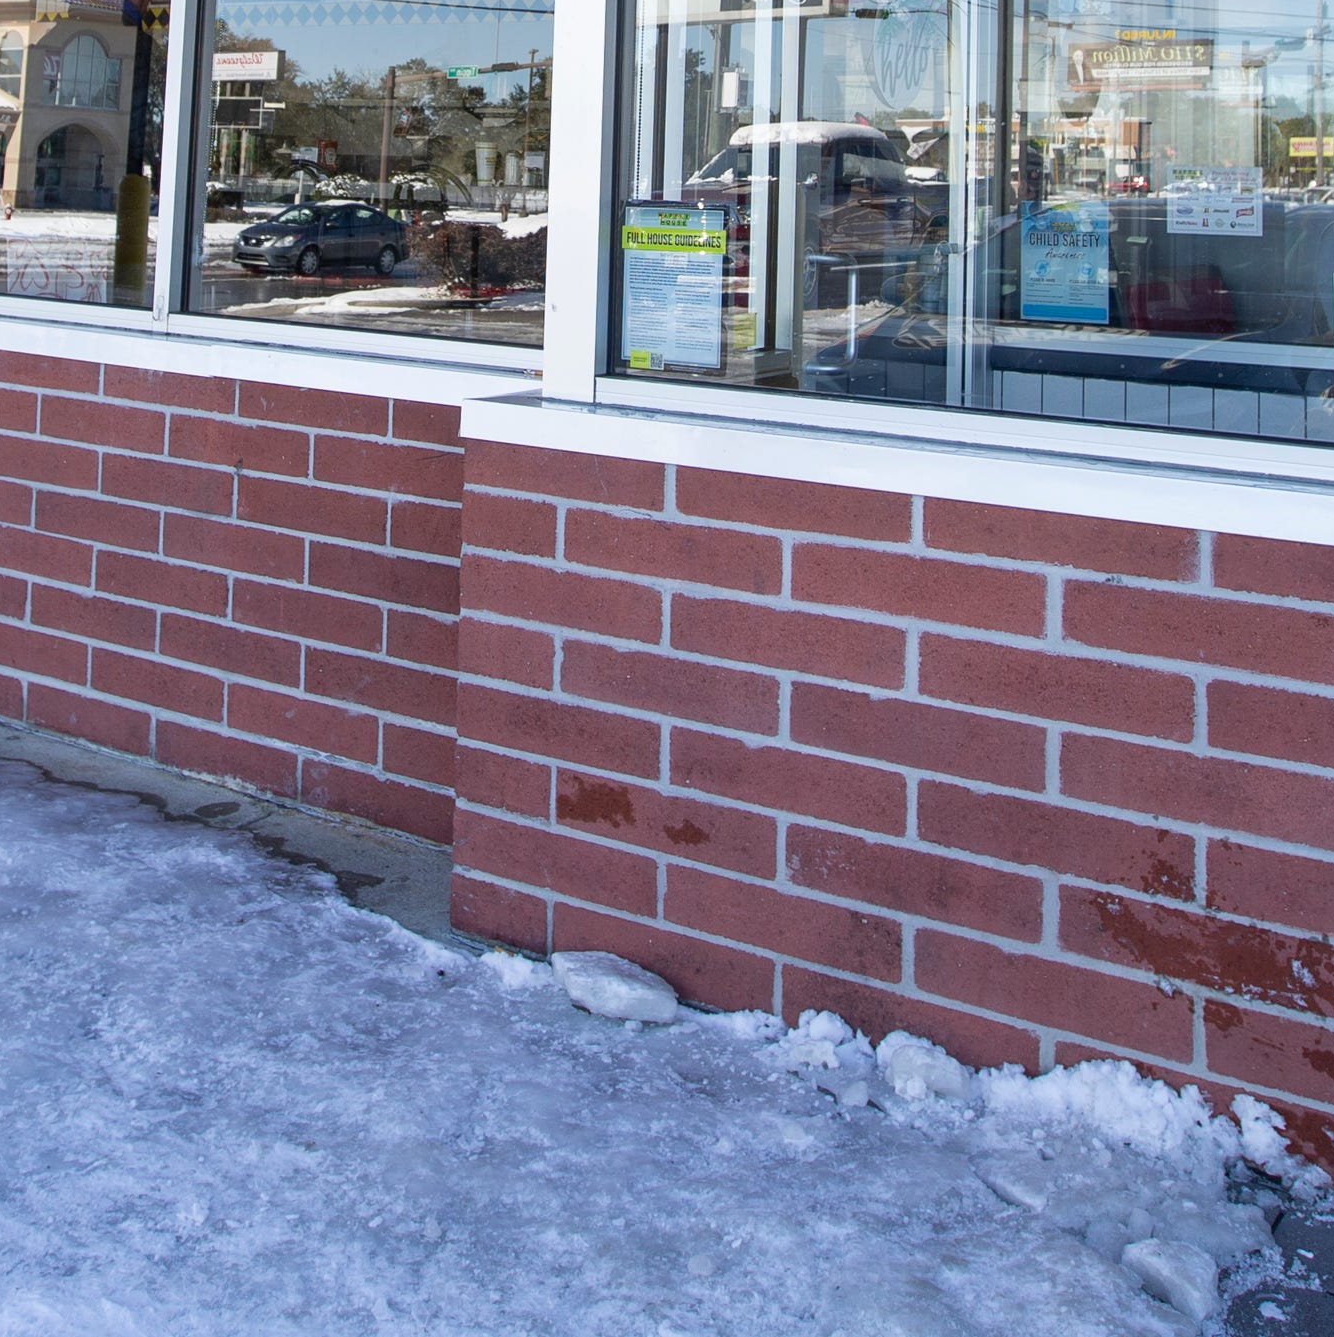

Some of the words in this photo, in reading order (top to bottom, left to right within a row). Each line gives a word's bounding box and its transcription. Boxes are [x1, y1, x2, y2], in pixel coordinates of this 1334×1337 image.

[626, 231, 646, 244] FULL
[647, 232, 673, 246] HOUSE
[674, 234, 722, 249] GUIDELINES
[1029, 232, 1059, 247] CHILD
[1062, 232, 1101, 248] SAFETY
